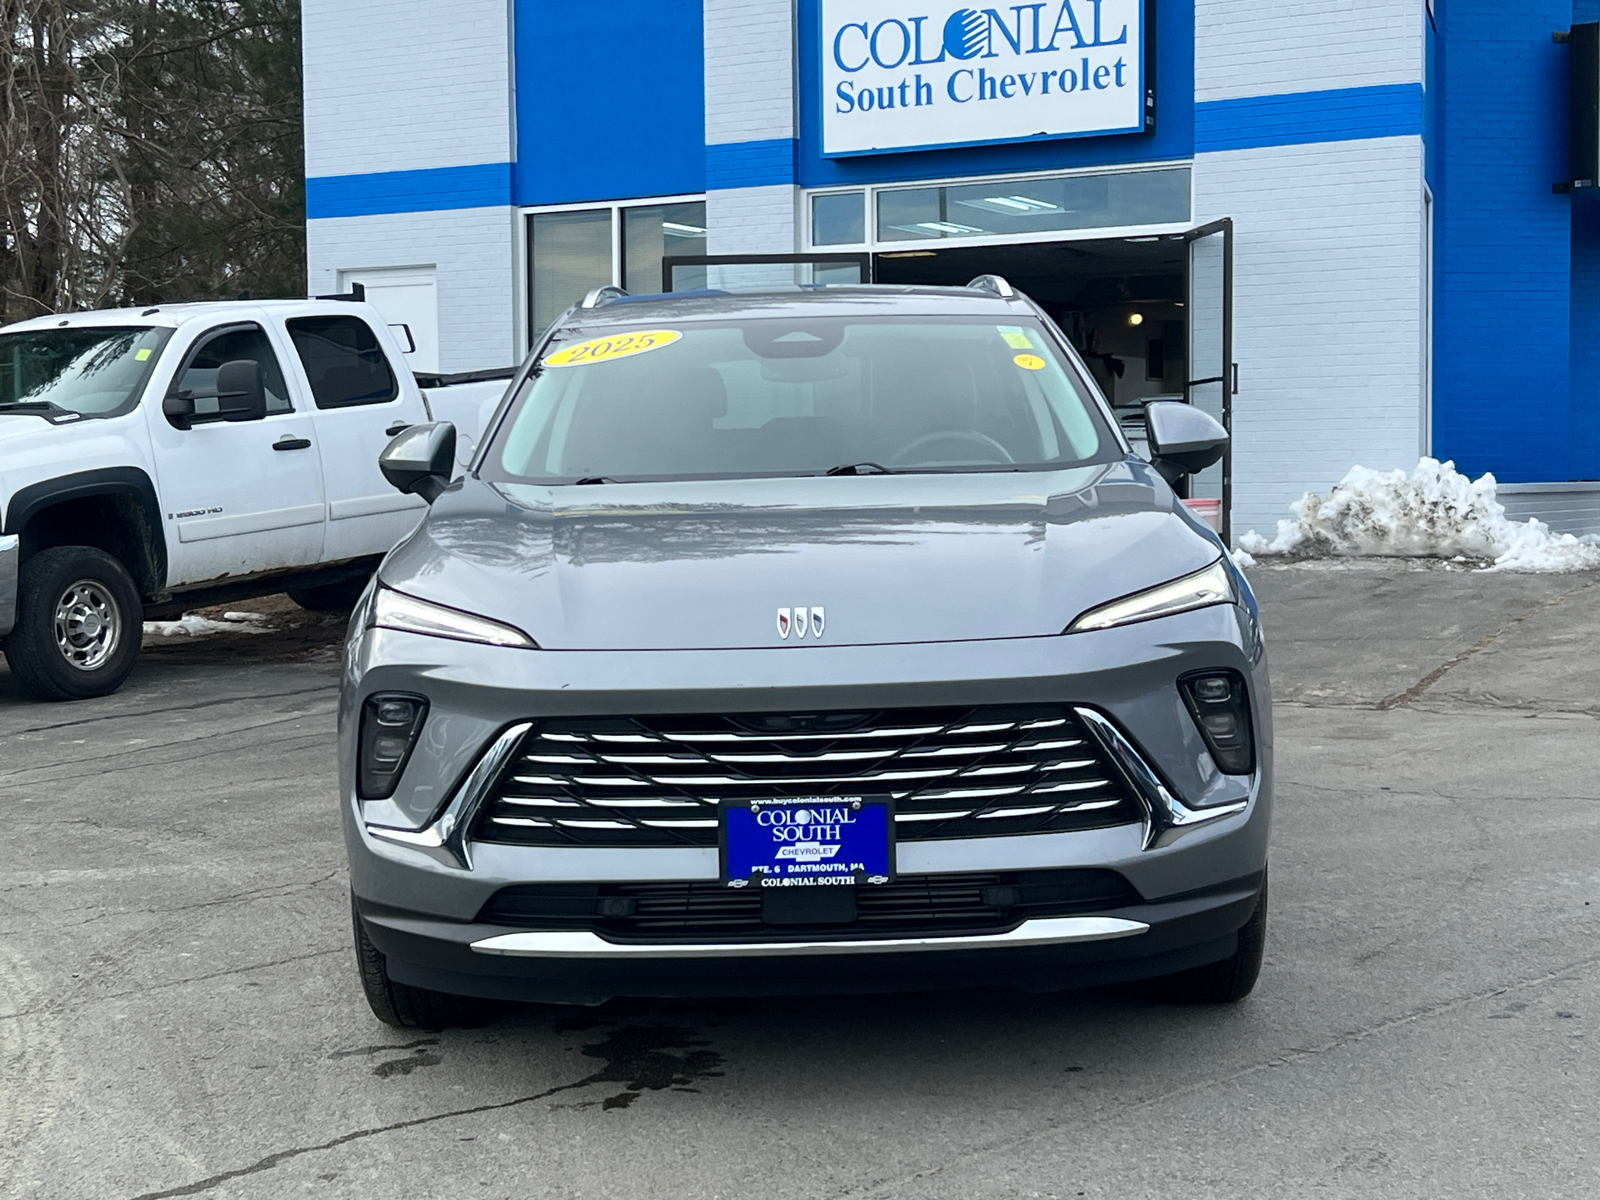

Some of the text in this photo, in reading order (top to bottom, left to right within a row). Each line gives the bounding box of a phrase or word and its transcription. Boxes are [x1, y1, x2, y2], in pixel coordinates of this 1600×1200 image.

[836, 56, 1128, 114] South Chevrolet
[567, 332, 658, 363] 2025
[750, 796, 862, 806] www.buycolonialsouth.com
[756, 808, 856, 826] COLONIAL
[772, 825, 841, 842] SOUTH
[781, 847, 834, 856] CHEVROLET
[774, 865, 781, 873] 6
[787, 863, 848, 873] DARTMOUTH,
[818, 876, 855, 885] SOUTH
